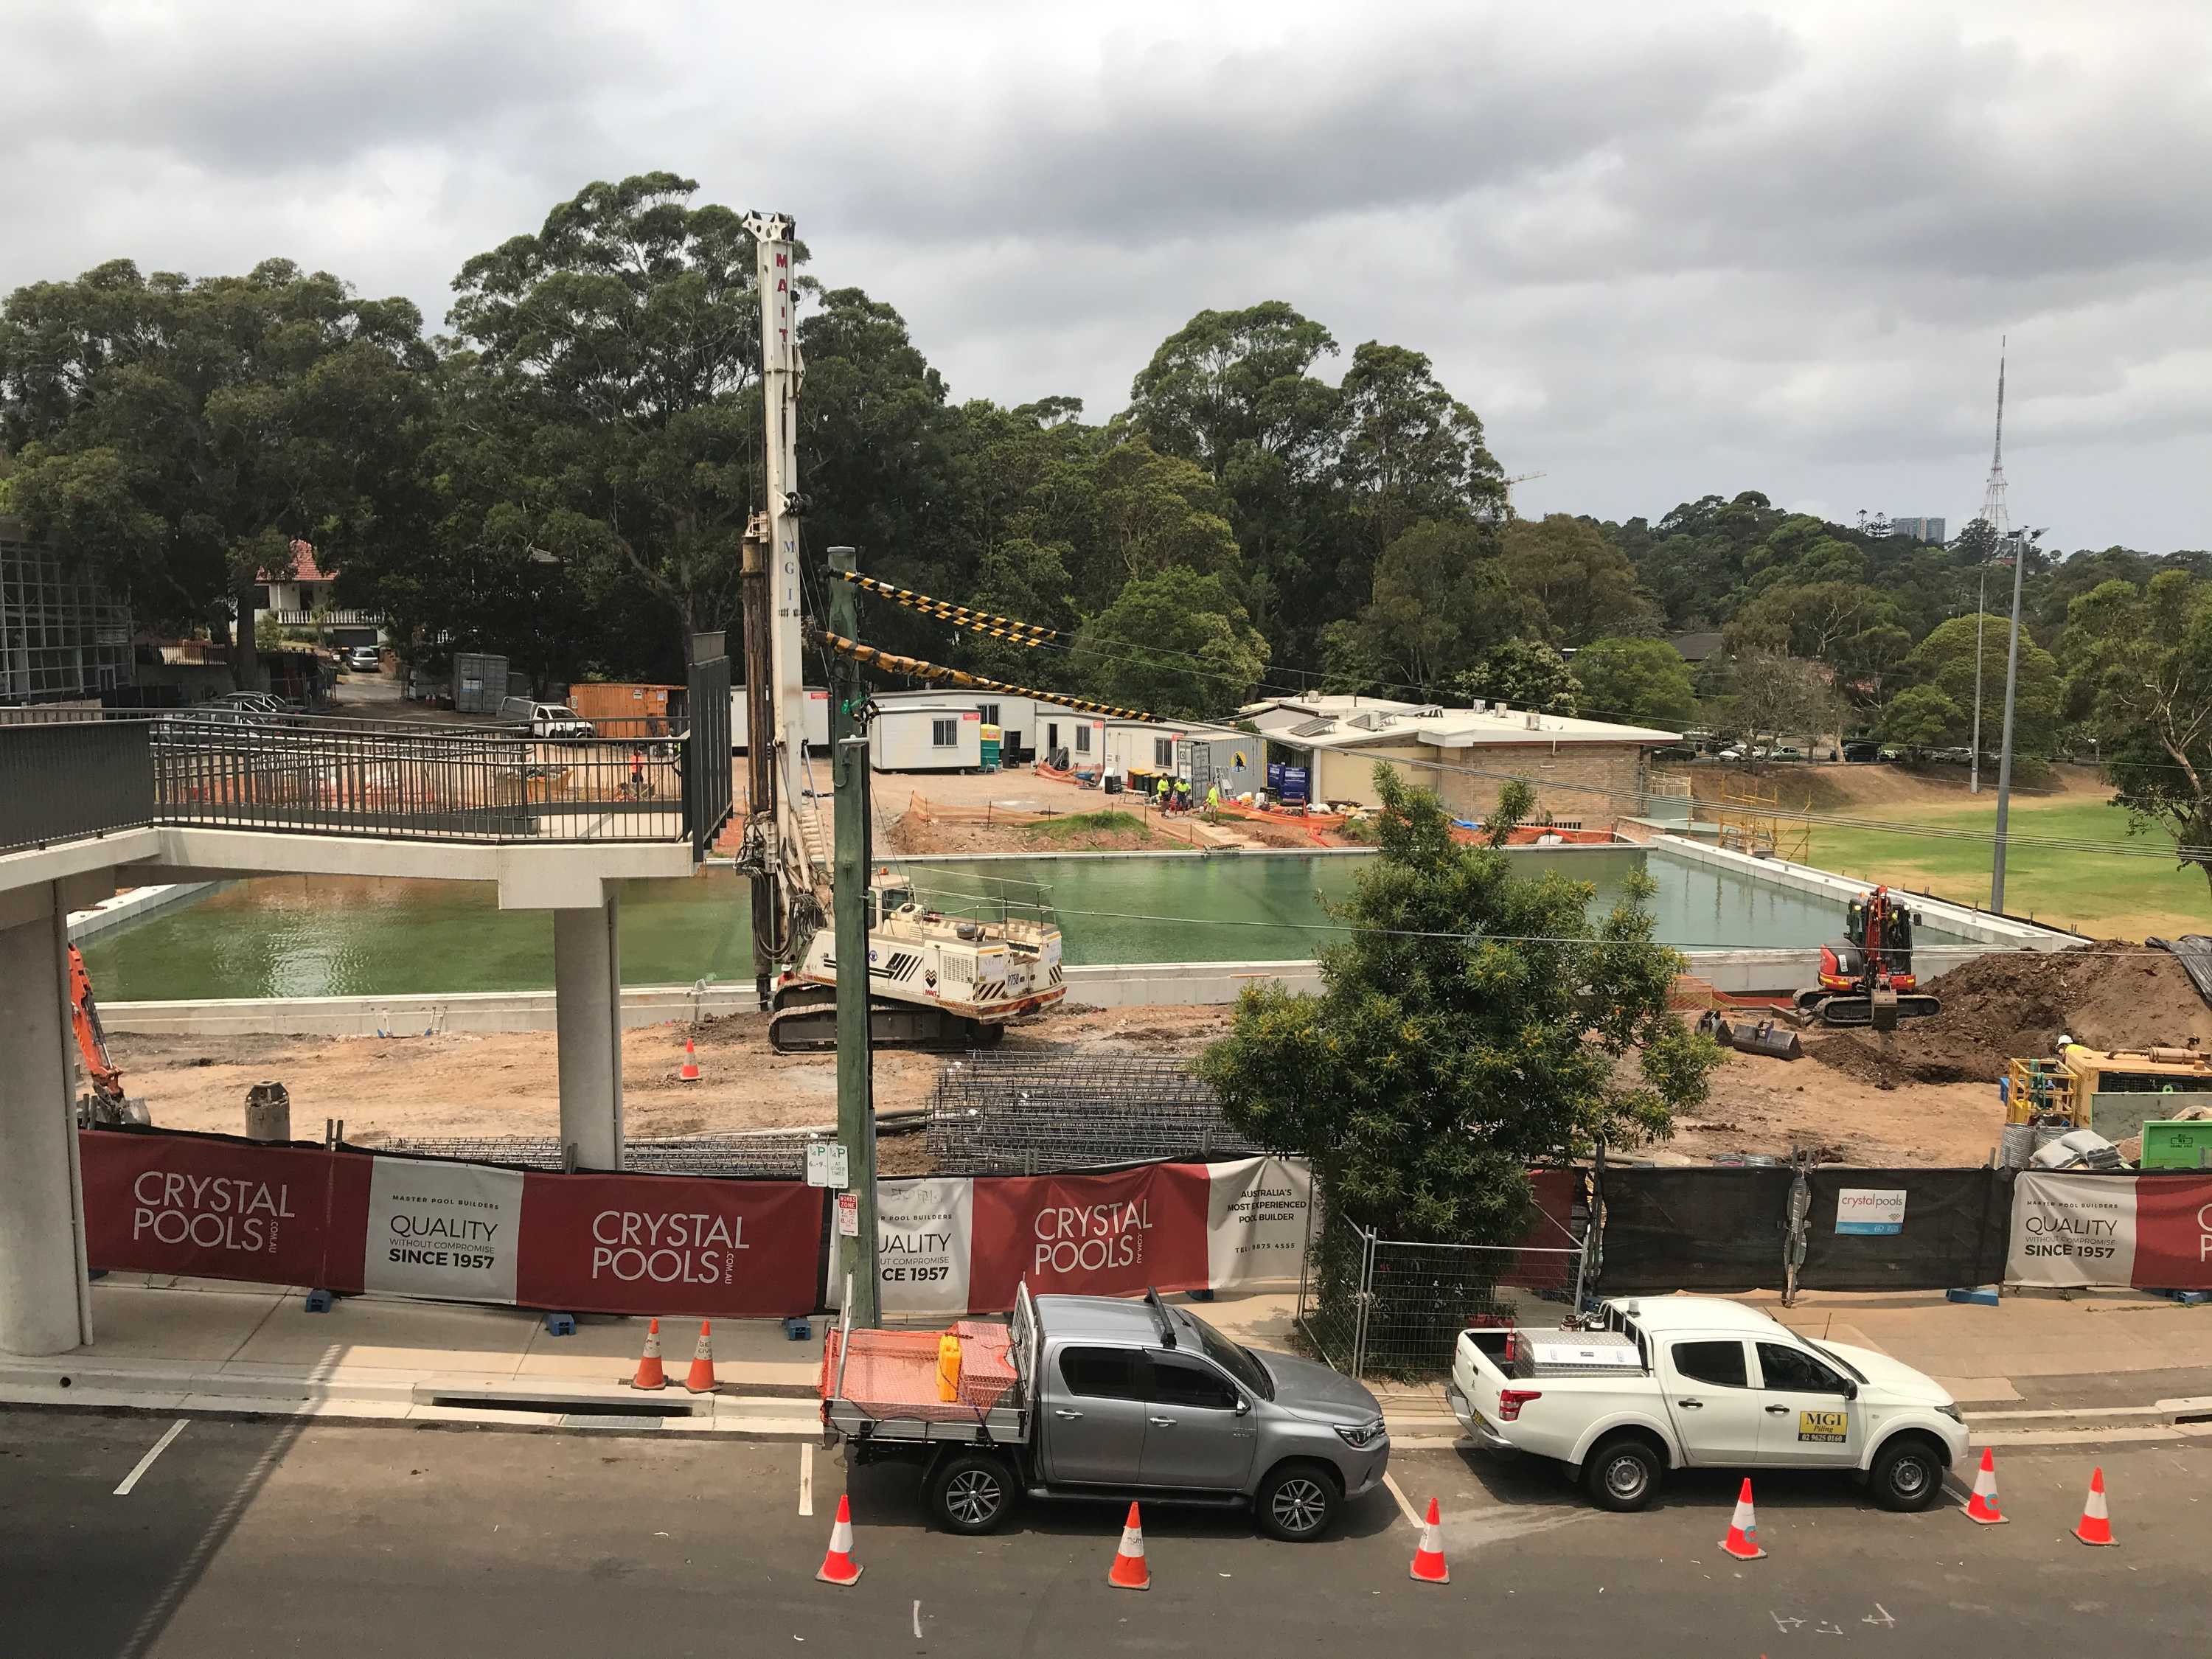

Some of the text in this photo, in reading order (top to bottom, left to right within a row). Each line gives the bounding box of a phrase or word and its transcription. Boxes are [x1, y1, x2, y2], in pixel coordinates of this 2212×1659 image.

[776, 253, 788, 343] MAIT
[784, 540, 795, 601] MGI
[134, 1171, 295, 1218] CRYSTAL
[392, 1194, 428, 1203] MASTER
[458, 1200, 499, 1210] BUILDERS
[1240, 1189, 1293, 1198] AUSTRALIA'S
[1227, 1201, 1307, 1211] MOST EXPERIENCED
[1034, 1199, 1152, 1240] CRYSTAL
[1259, 1213, 1295, 1221] BUILDER
[2025, 1216, 2118, 1236] QUALITY
[133, 1208, 263, 1251] POOLS
[390, 1215, 498, 1242] QUALITY
[592, 1211, 749, 1248] CRYSTAL
[389, 1238, 495, 1254] WITHOUT COMPROMISE
[878, 1233, 951, 1253] UALITY
[2025, 1244, 2115, 1259] SINCE 1957
[389, 1248, 495, 1270] SINCE 1957
[892, 1256, 950, 1265] COMPROMISE
[1035, 1235, 1133, 1275] POOLS
[592, 1247, 720, 1284] POOLS
[724, 1251, 734, 1284] .COM.AU
[910, 1266, 950, 1281] 1957
[1806, 1413, 1842, 1425] MGI
[1814, 1425, 1834, 1433] Piling
